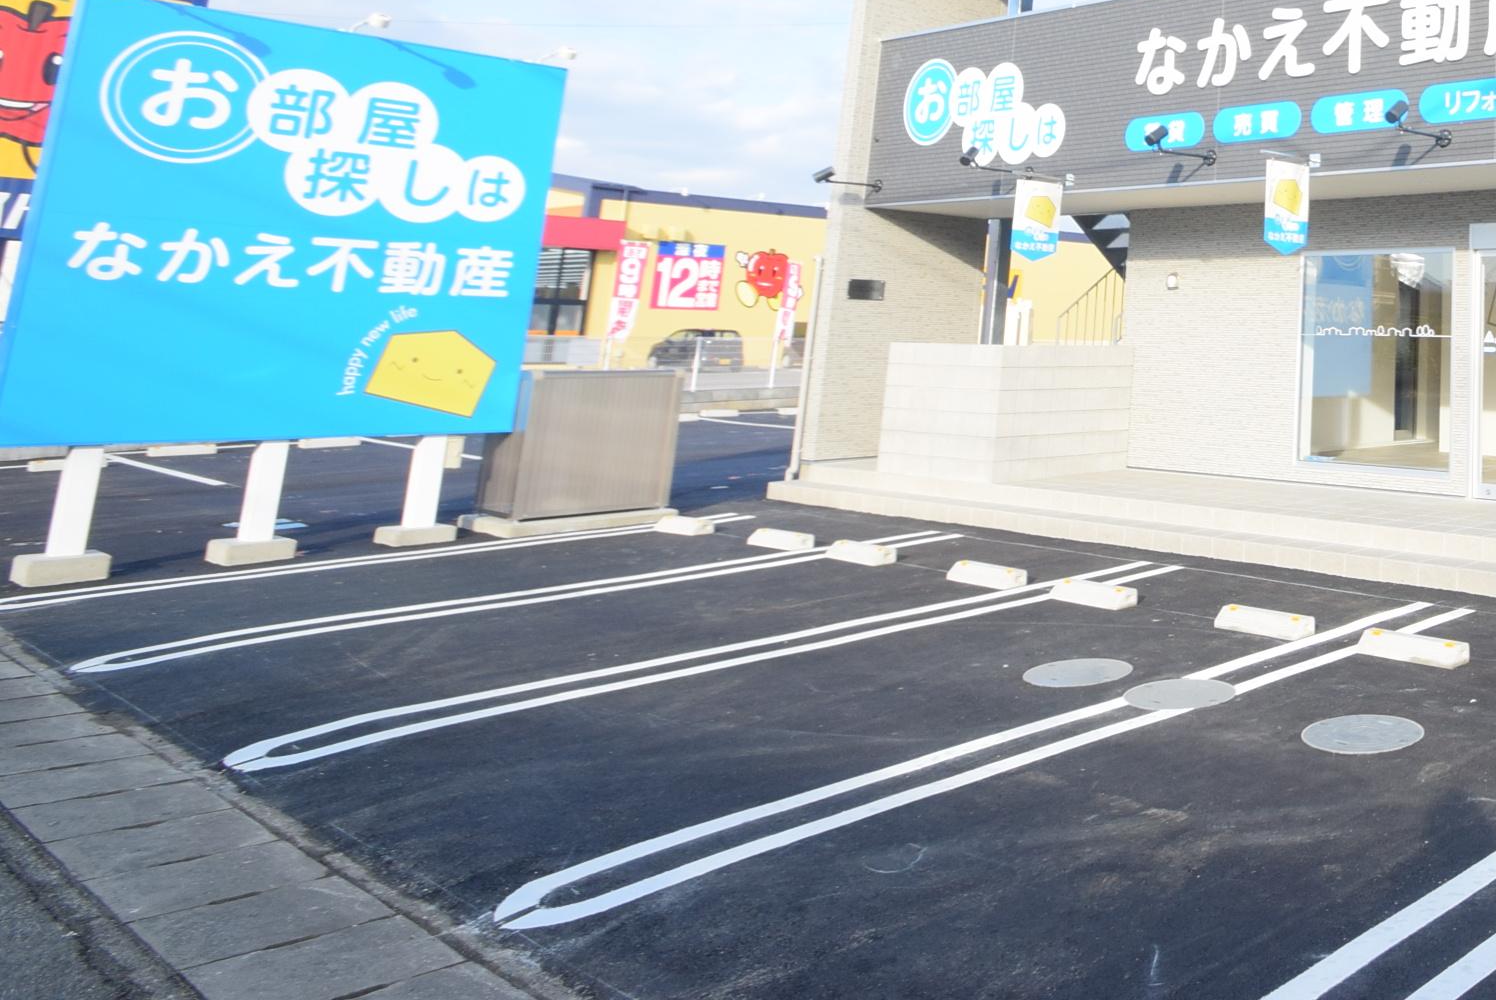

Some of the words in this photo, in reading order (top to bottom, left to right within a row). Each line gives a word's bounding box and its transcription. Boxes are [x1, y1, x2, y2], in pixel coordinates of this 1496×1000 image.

[140, 57, 423, 151] お部屋
[914, 74, 1016, 125] お部屋
[1233, 109, 1281, 137] 売買
[1333, 98, 1386, 127] 管理
[970, 116, 1058, 155] 探しは
[301, 148, 510, 208] 探しは
[66, 220, 515, 299] なかえ不動産
[336, 348, 369, 396] happy
[360, 319, 390, 347] new
[388, 304, 419, 324] life
